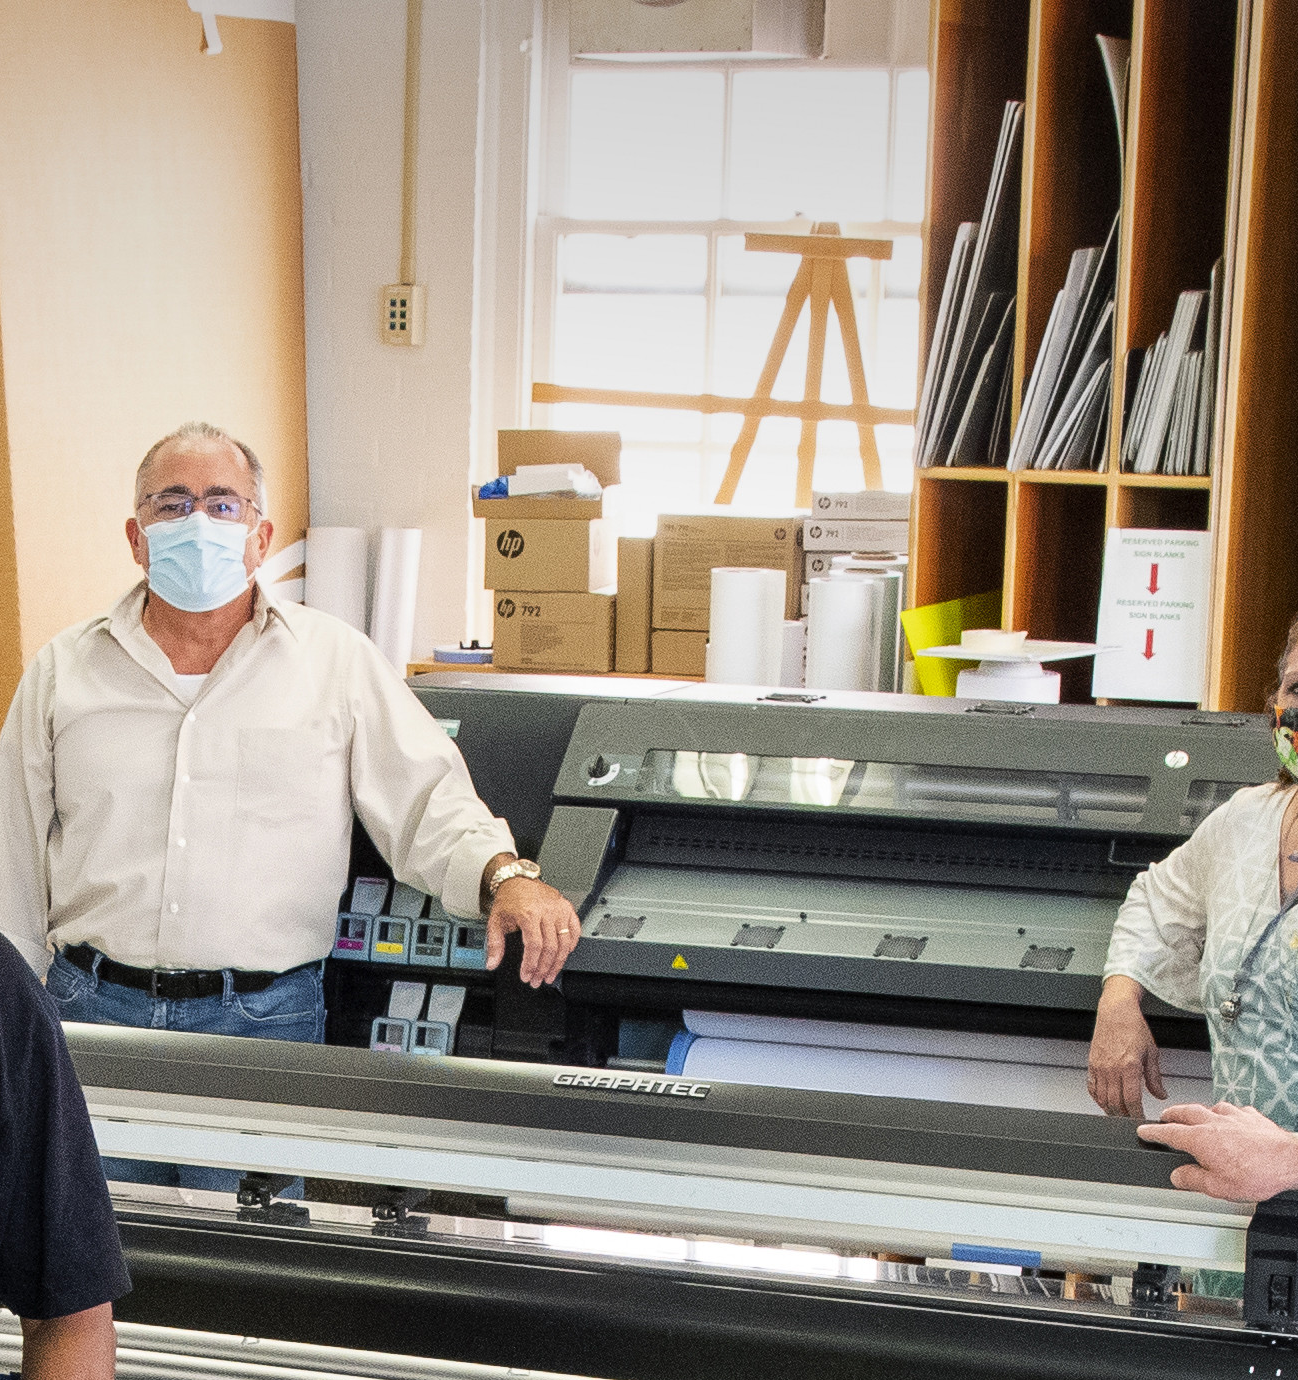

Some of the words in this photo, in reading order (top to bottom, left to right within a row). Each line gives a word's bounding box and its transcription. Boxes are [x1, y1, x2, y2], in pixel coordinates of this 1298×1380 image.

[497, 529, 525, 559] hp
[1122, 538, 1162, 546] RESERVED
[1164, 539, 1199, 548] PARKING
[1116, 599, 1158, 607] RESERVED
[1160, 600, 1195, 609] PARKING
[522, 606, 541, 617] 792
[553, 1073, 710, 1098] GRAPHTEC
